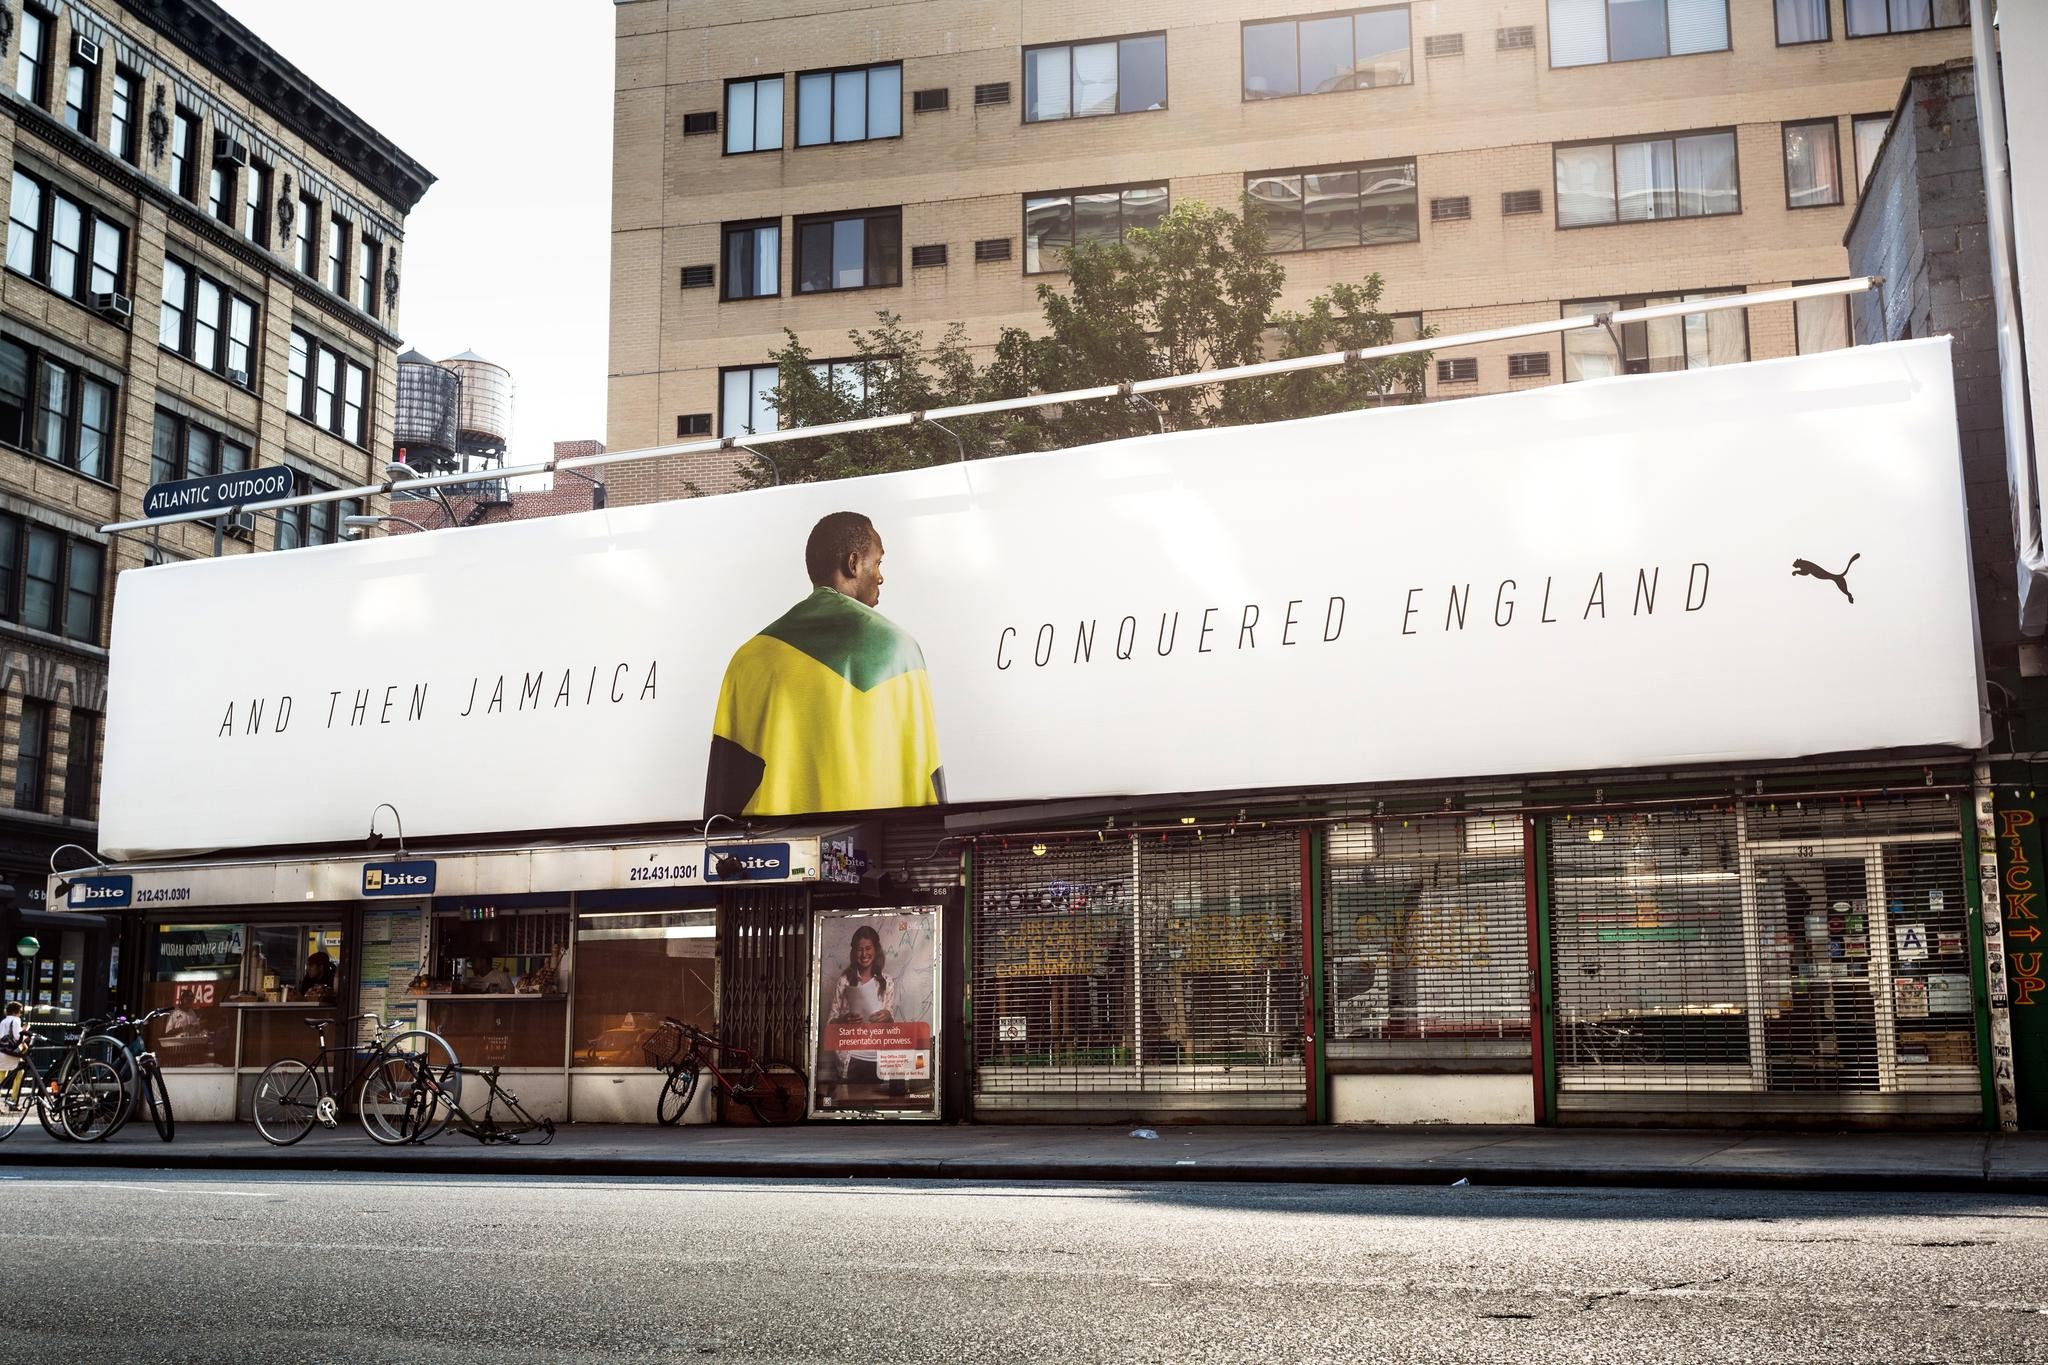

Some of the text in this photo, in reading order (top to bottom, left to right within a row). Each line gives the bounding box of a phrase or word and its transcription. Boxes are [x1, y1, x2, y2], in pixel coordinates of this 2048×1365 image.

[149, 475, 285, 510] ATLANTIC OUTDOOR
[997, 562, 1710, 671] CONQUERED ENGLAND
[218, 660, 657, 738] AND THEN JAMAICA
[846, 856, 865, 867] bite
[383, 872, 428, 886] bite
[630, 864, 698, 882] 212.431.0301
[28, 889, 40, 900] 45
[86, 886, 125, 898] bite
[137, 887, 191, 902] 212.431.0301
[933, 887, 947, 896] 868
[1903, 928, 1922, 949] A
[2008, 952, 2046, 1005] UP
[839, 1026, 901, 1038] Start the year with
[838, 1037, 912, 1047] presentation prowess.
